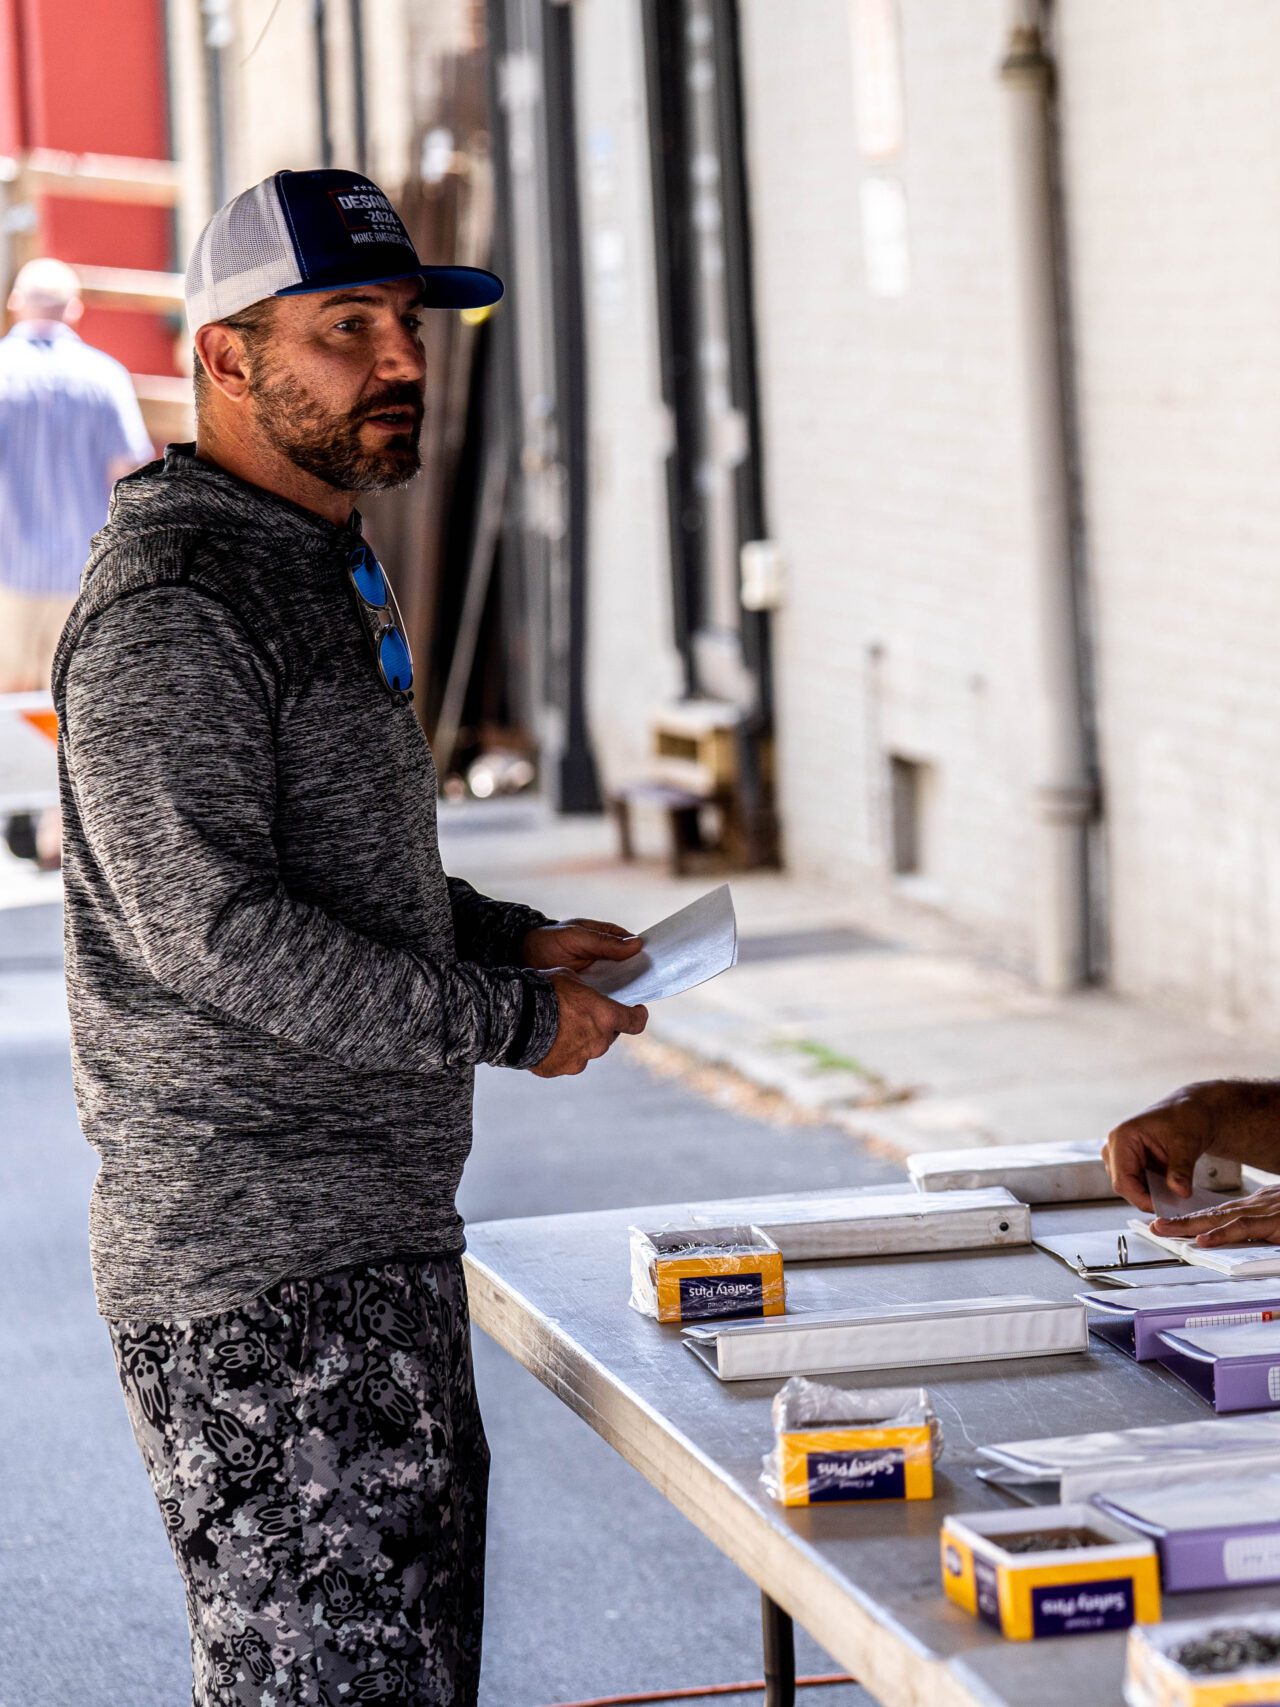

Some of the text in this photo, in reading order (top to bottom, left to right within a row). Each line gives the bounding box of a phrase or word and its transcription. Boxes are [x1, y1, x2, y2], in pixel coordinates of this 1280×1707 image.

[689, 1281, 753, 1298] Safety Pins
[816, 1461, 848, 1477] Pins
